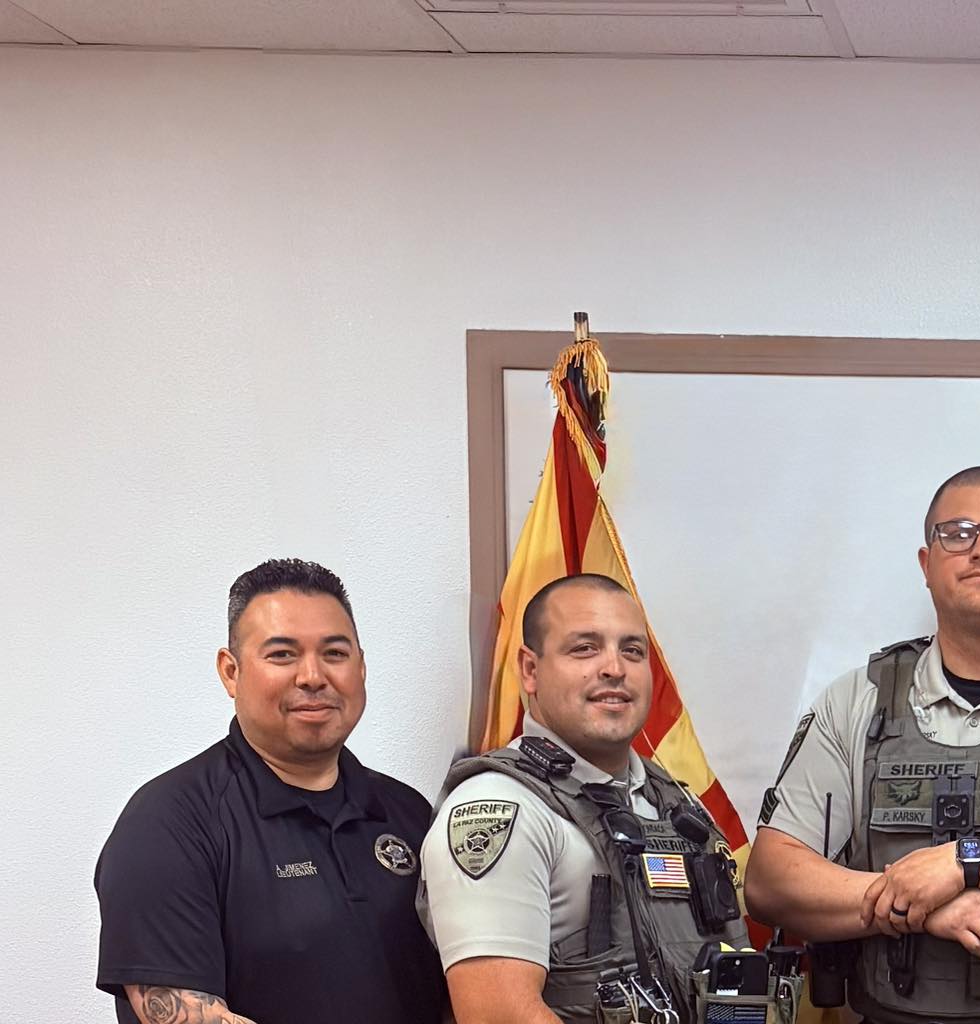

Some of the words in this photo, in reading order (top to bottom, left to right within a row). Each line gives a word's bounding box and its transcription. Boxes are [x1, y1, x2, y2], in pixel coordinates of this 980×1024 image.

[890, 764, 966, 776] SHERIFF
[453, 804, 511, 818] SHERIFF
[892, 812, 926, 822] KARSKY
